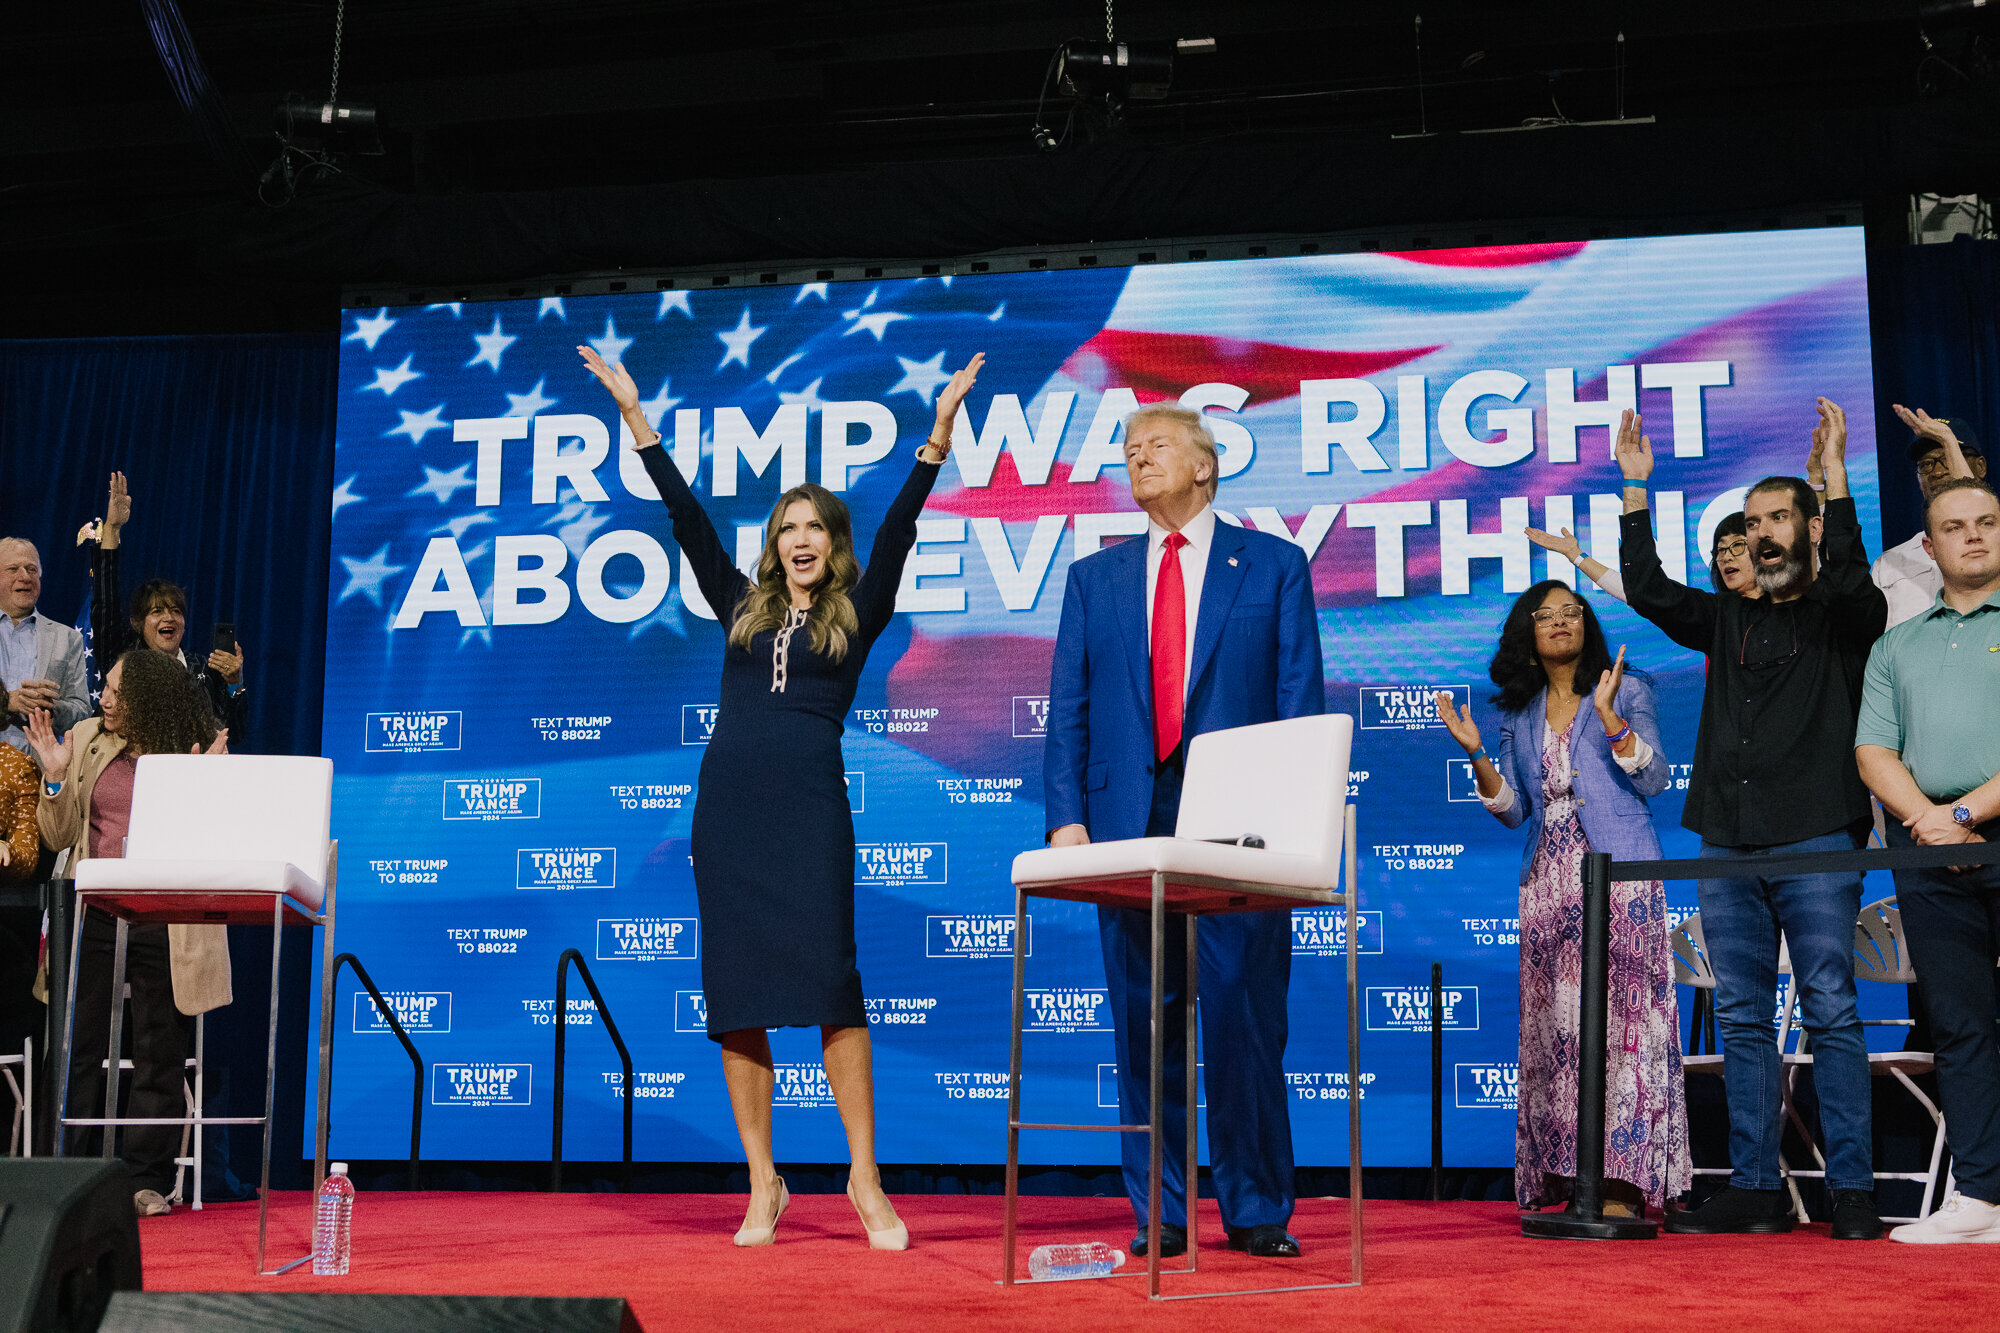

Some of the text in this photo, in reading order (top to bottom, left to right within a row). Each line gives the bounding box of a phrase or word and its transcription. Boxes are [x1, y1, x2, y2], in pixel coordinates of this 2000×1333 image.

[452, 360, 1730, 507] TRUMP WAS RIGHT
[855, 708, 939, 720] TEXT TRUMP
[380, 716, 448, 731] TRUMP
[531, 716, 612, 728] TEXT TRUMP
[865, 722, 929, 733] TO 88022
[387, 730, 440, 742] VANCE
[541, 729, 601, 740] TO 88022
[936, 778, 1023, 790] TEXT TRUMP
[457, 783, 527, 798] TRUMP
[610, 785, 692, 796] TEXT TRUMP
[620, 798, 681, 809] TO 88022
[948, 792, 1012, 803] TO 88022
[465, 798, 518, 810] VANCE
[858, 847, 932, 863] TRUMP
[1373, 844, 1464, 856] TEXT TRUMP
[369, 859, 448, 871] TEXT TRUMP
[531, 853, 602, 867] TRUMP
[1385, 858, 1453, 870] TO 88022
[539, 867, 593, 879] VANCE
[867, 862, 924, 875] VANCE
[378, 873, 438, 883] TO 88022
[611, 923, 683, 938] TRUMP
[941, 920, 1017, 935] TRUMP
[1462, 919, 1499, 930] TEXT
[447, 928, 527, 939] TEXT TRUMP
[1297, 932, 1346, 944] VANC
[1474, 934, 1494, 945] TO
[619, 938, 674, 950] VANCE
[950, 935, 1008, 947] VANCE
[457, 943, 517, 953] TO 88022
[522, 1000, 598, 1011] TEXT RUM
[889, 998, 937, 1009] TRUMP
[1027, 993, 1104, 1009] TRUMP
[376, 1011, 429, 1023] VNCE
[532, 1014, 550, 1025] TO
[884, 1013, 926, 1024] 88022
[1036, 1009, 1095, 1021] VANCE
[1392, 1007, 1453, 1020] VANE
[447, 1068, 517, 1083] TRUMP
[639, 1072, 685, 1083] TRUMP
[773, 1069, 829, 1083] TRUM
[935, 1073, 1022, 1084] TEXT TRUM
[1285, 1073, 1322, 1084] TEXT
[1471, 1069, 1518, 1084] TRU
[455, 1083, 509, 1095] VANCE
[634, 1087, 674, 1098] 88022
[946, 1088, 965, 1098] TO
[1296, 1088, 1365, 1099] TO 8802
[1481, 1085, 1519, 1097] VAN
